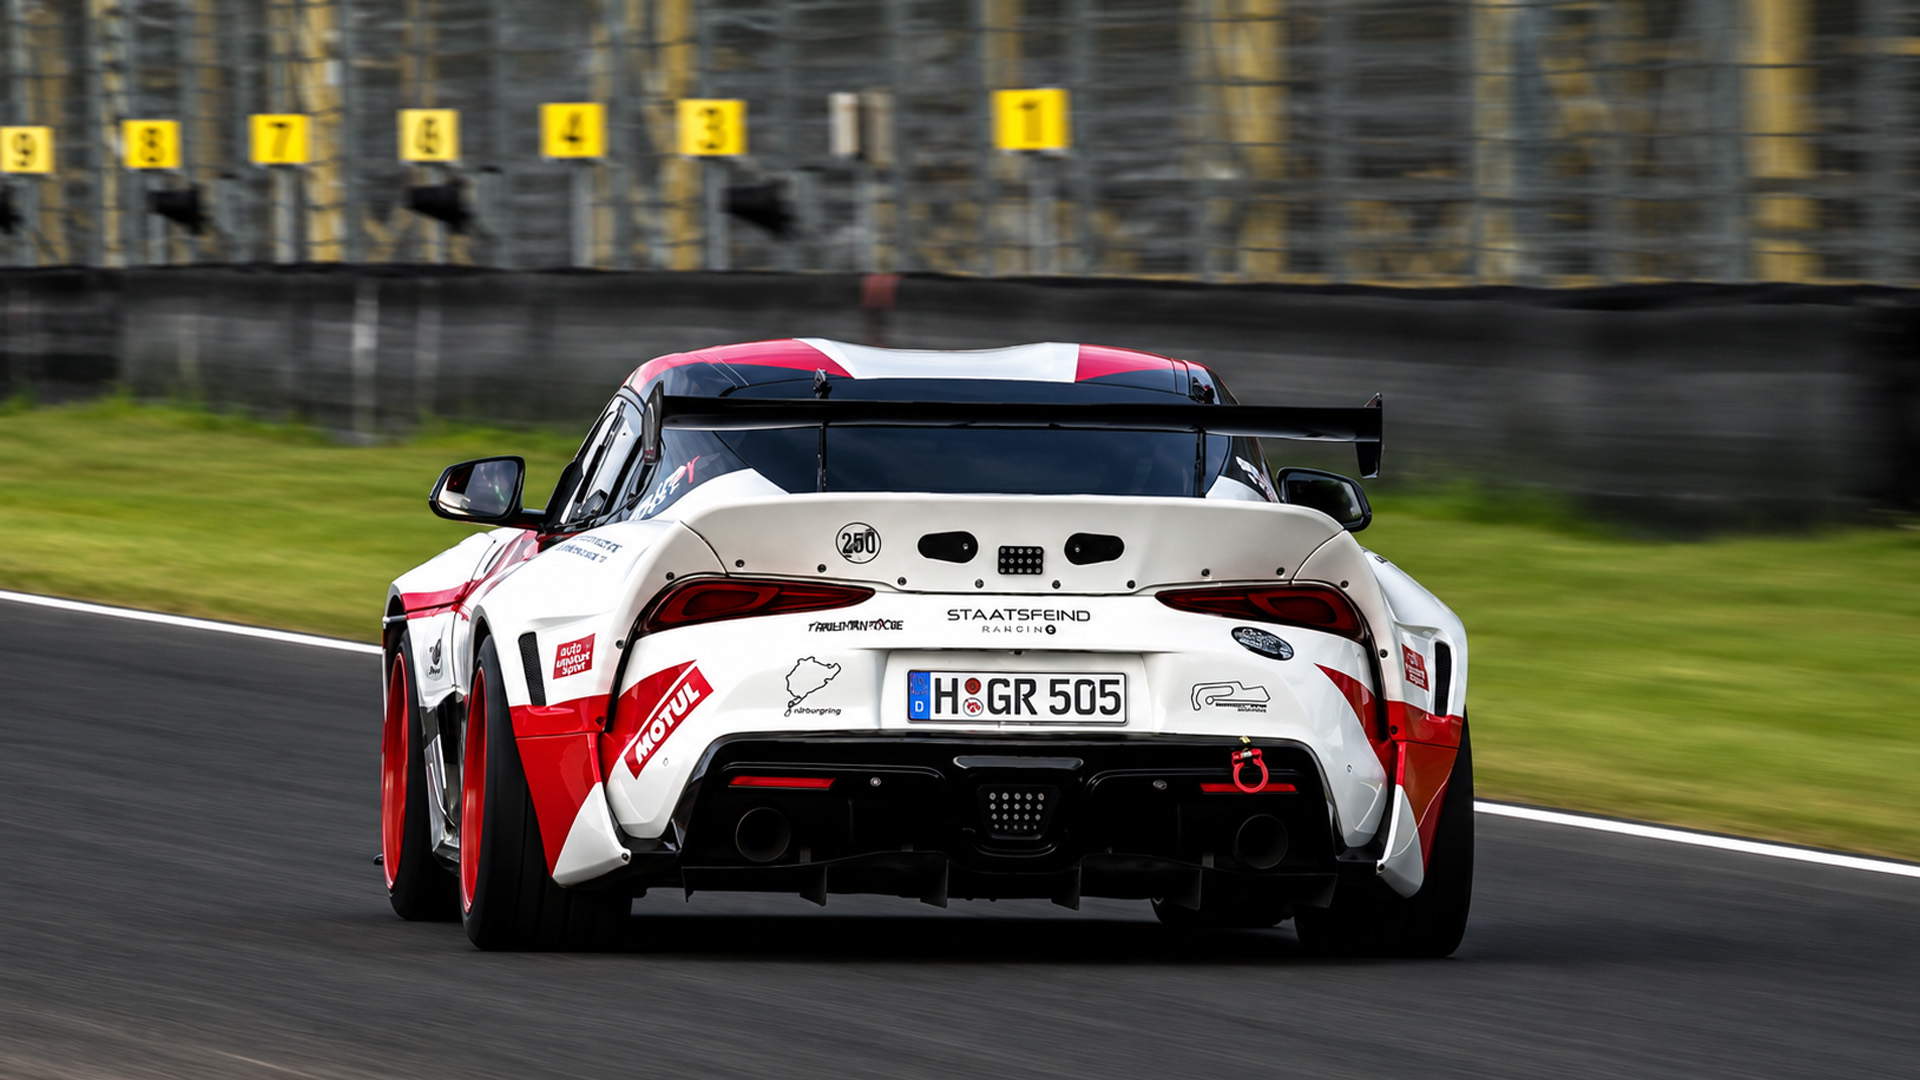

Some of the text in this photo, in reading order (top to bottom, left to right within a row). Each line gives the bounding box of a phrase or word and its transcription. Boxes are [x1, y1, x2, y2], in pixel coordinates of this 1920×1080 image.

[267, 121, 292, 158] 7
[560, 112, 585, 152] 4
[695, 107, 727, 150] 3
[1014, 100, 1044, 142] 1
[11, 132, 36, 168] 9
[139, 127, 165, 163] 8
[842, 531, 876, 554] 250
[946, 608, 1091, 622] STAATSFEIND
[914, 700, 925, 713] D
[933, 677, 1121, 716] H GR 505
[634, 681, 701, 765] MOTUL
